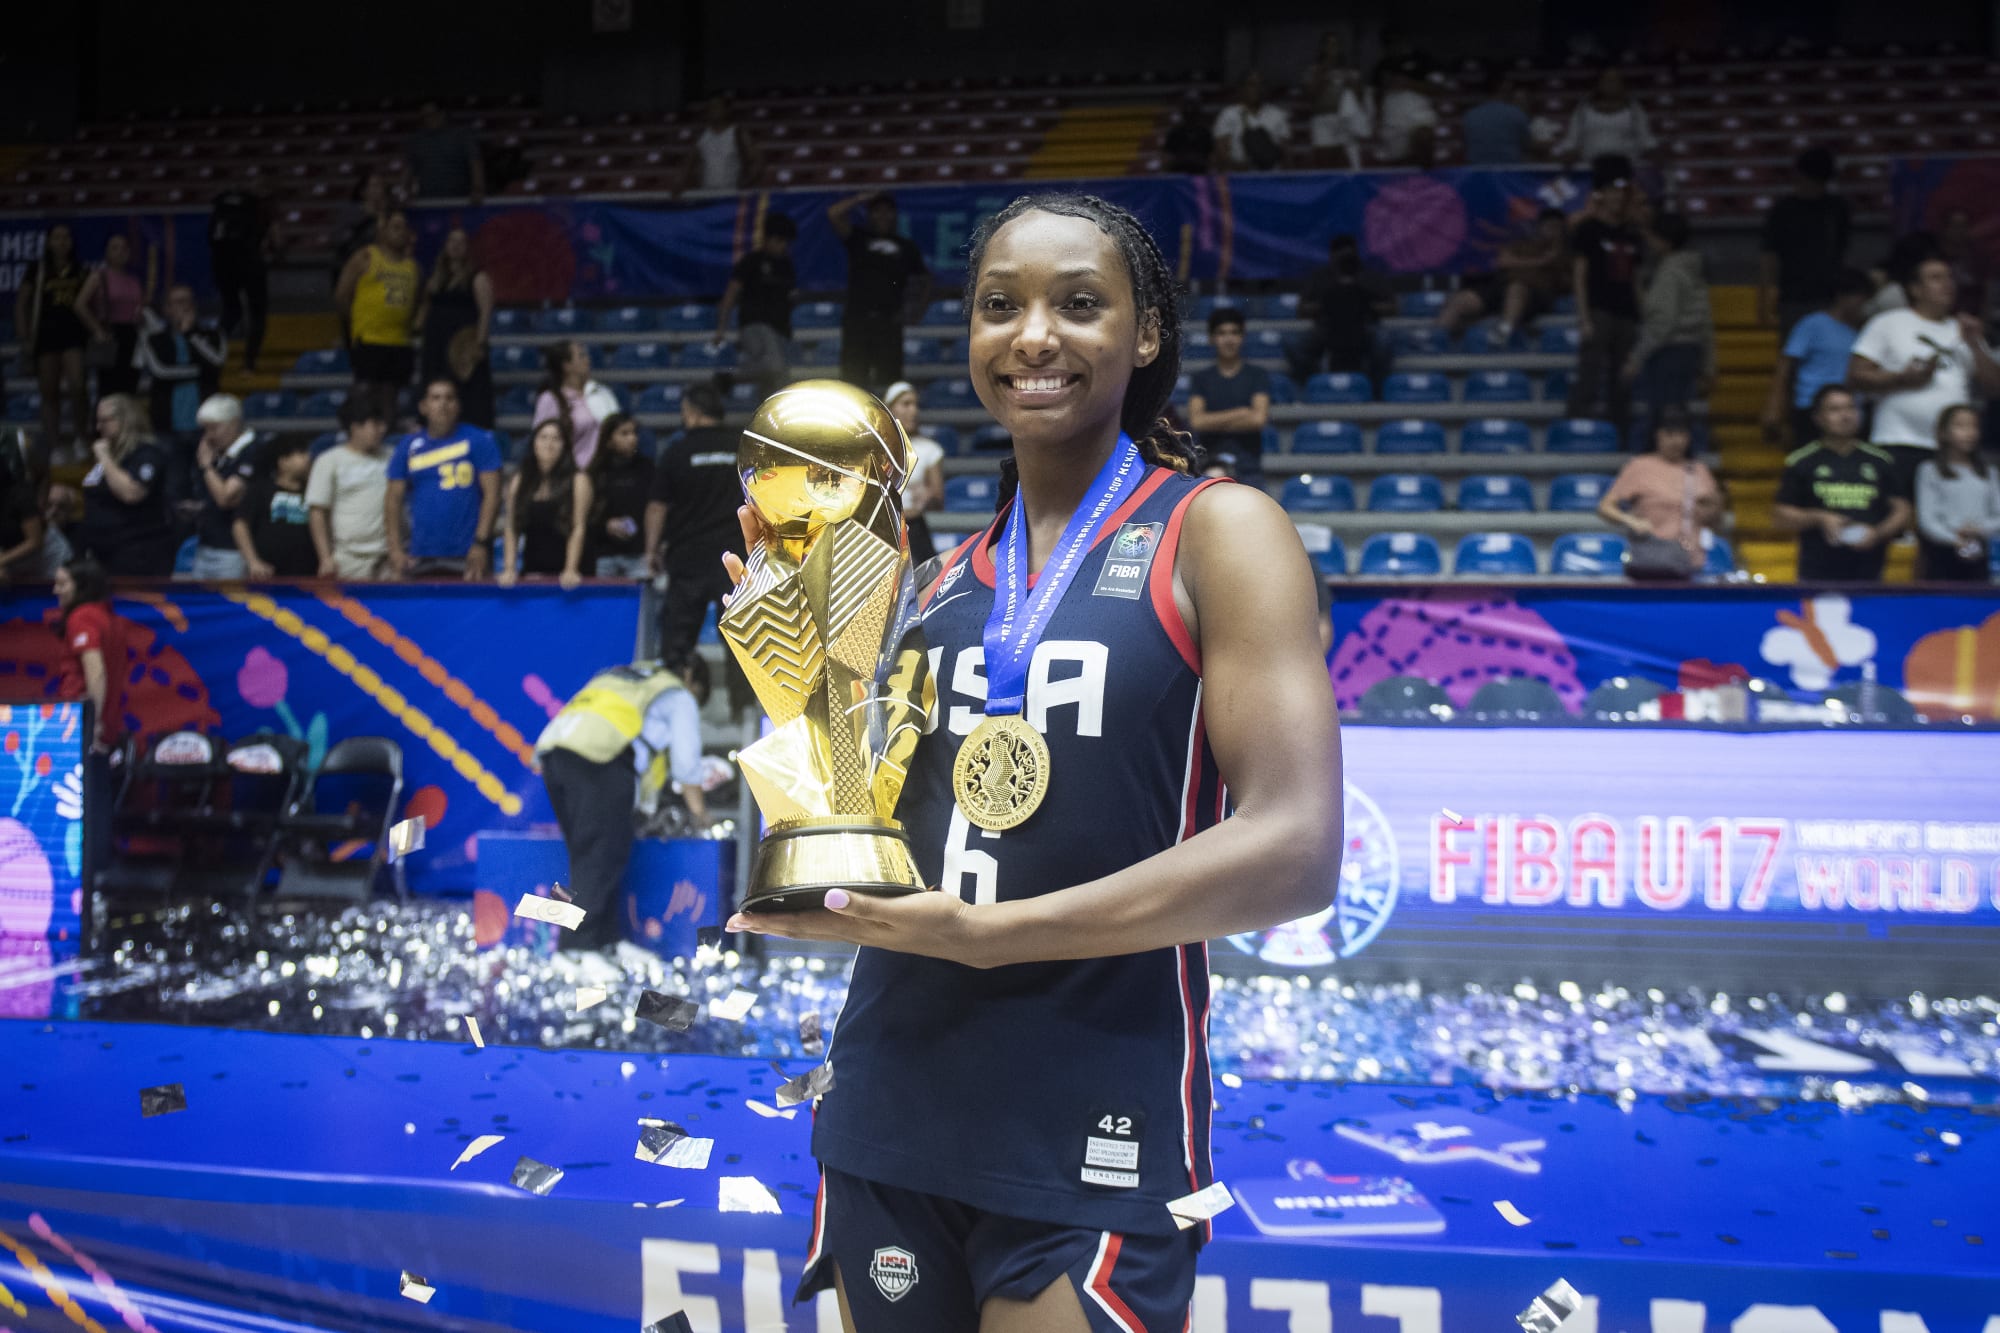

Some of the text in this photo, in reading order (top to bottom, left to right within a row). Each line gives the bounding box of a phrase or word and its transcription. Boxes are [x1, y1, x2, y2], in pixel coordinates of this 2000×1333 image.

[438, 461, 474, 490] 30
[1008, 545, 1016, 573] WORLD
[1014, 631, 1031, 655] FIBA
[1025, 614, 1040, 630] U17
[1035, 572, 1065, 612] WOMEN'S
[1059, 519, 1097, 571] BASKETBALL
[1091, 493, 1114, 518] WORLD
[1108, 476, 1124, 493] CUP
[1107, 564, 1141, 579] FIBA
[1008, 573, 1016, 590] CUP
[941, 801, 1001, 906] 6
[1433, 815, 1788, 908] FIBA U17
[1796, 854, 1979, 911] WORLD
[1098, 1114, 1132, 1135] 42
[880, 1255, 908, 1271] USA
